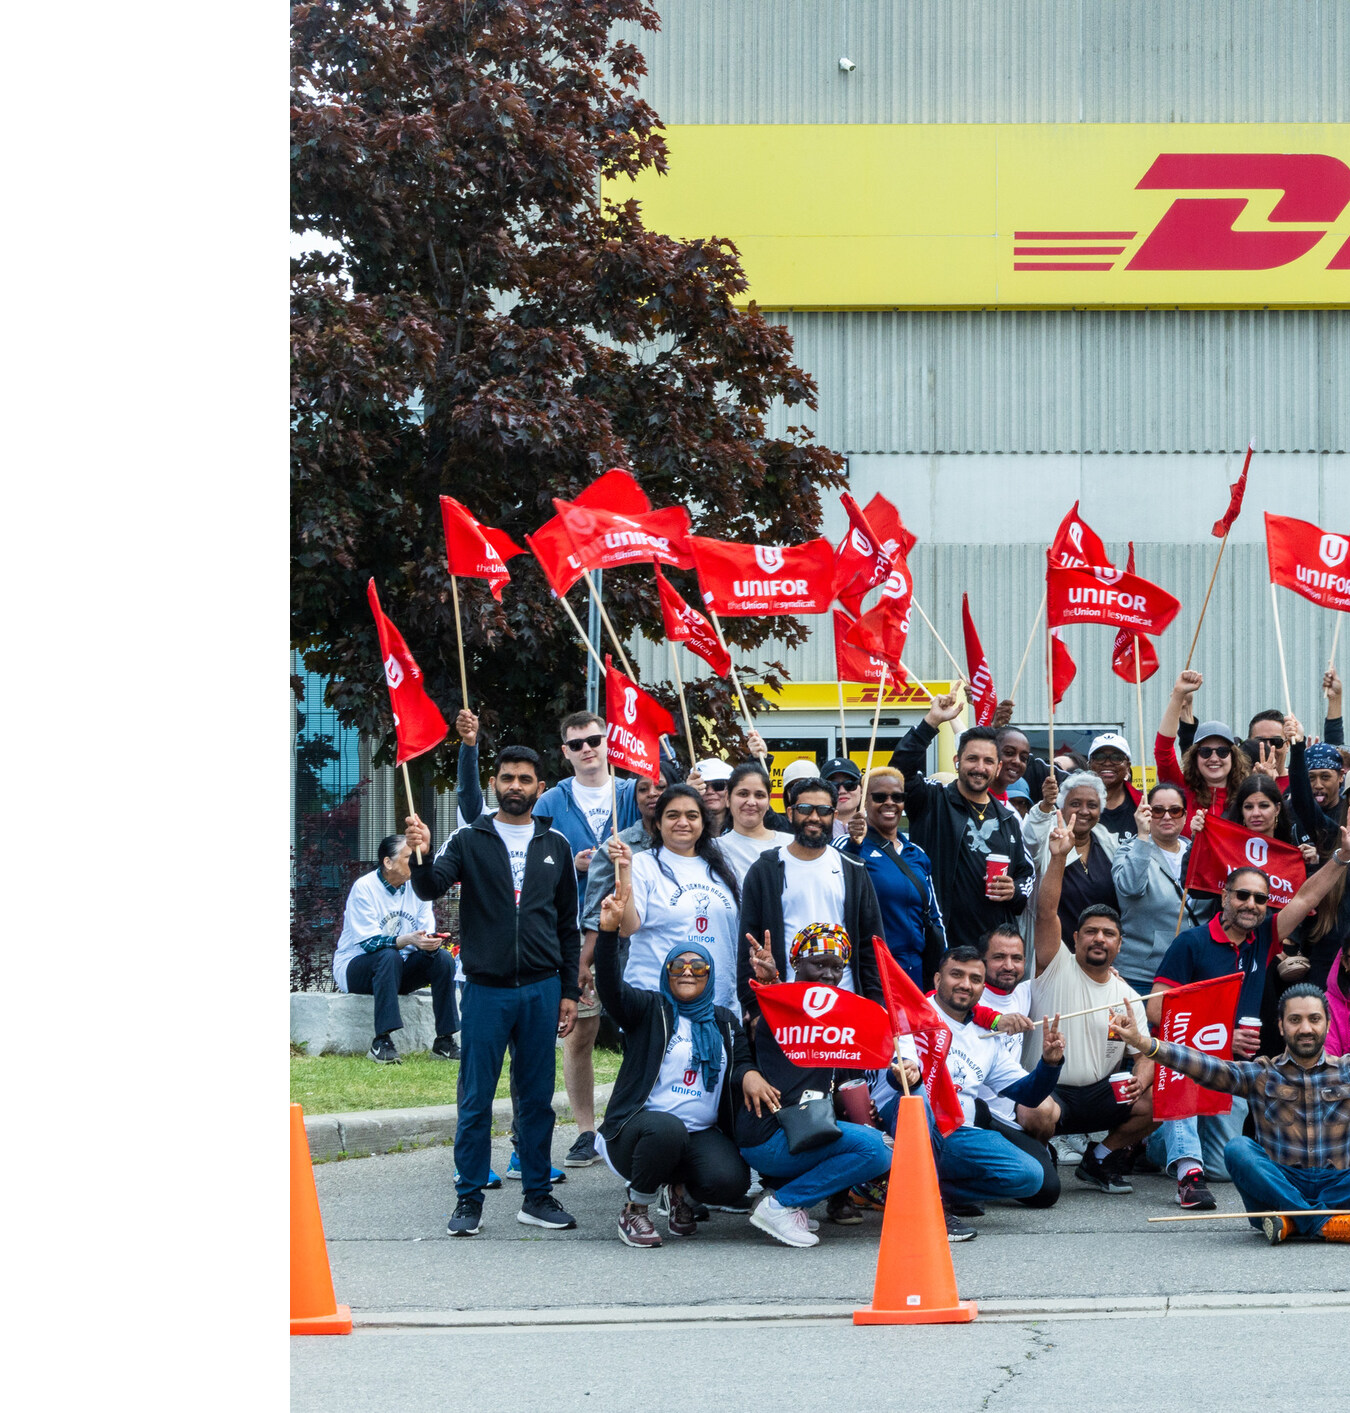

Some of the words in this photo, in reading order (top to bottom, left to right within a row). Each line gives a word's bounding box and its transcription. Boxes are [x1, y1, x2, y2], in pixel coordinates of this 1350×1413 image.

[604, 531, 670, 551] UNIFOR
[733, 579, 809, 597] UNIFOR
[728, 600, 768, 610] theUnion
[773, 600, 816, 610] lesyndicat
[1068, 587, 1147, 612] UNIFOR
[1063, 607, 1100, 617] theUnion
[1107, 609, 1153, 627] lesyndicat
[860, 688, 932, 702] DHL
[688, 935, 715, 943] UNIFOR
[774, 1026, 856, 1045] UNIFOR
[811, 1049, 861, 1061] lesyndicat
[1157, 1065, 1168, 1091] ndicat
[671, 1085, 702, 1098] UNIFOR
